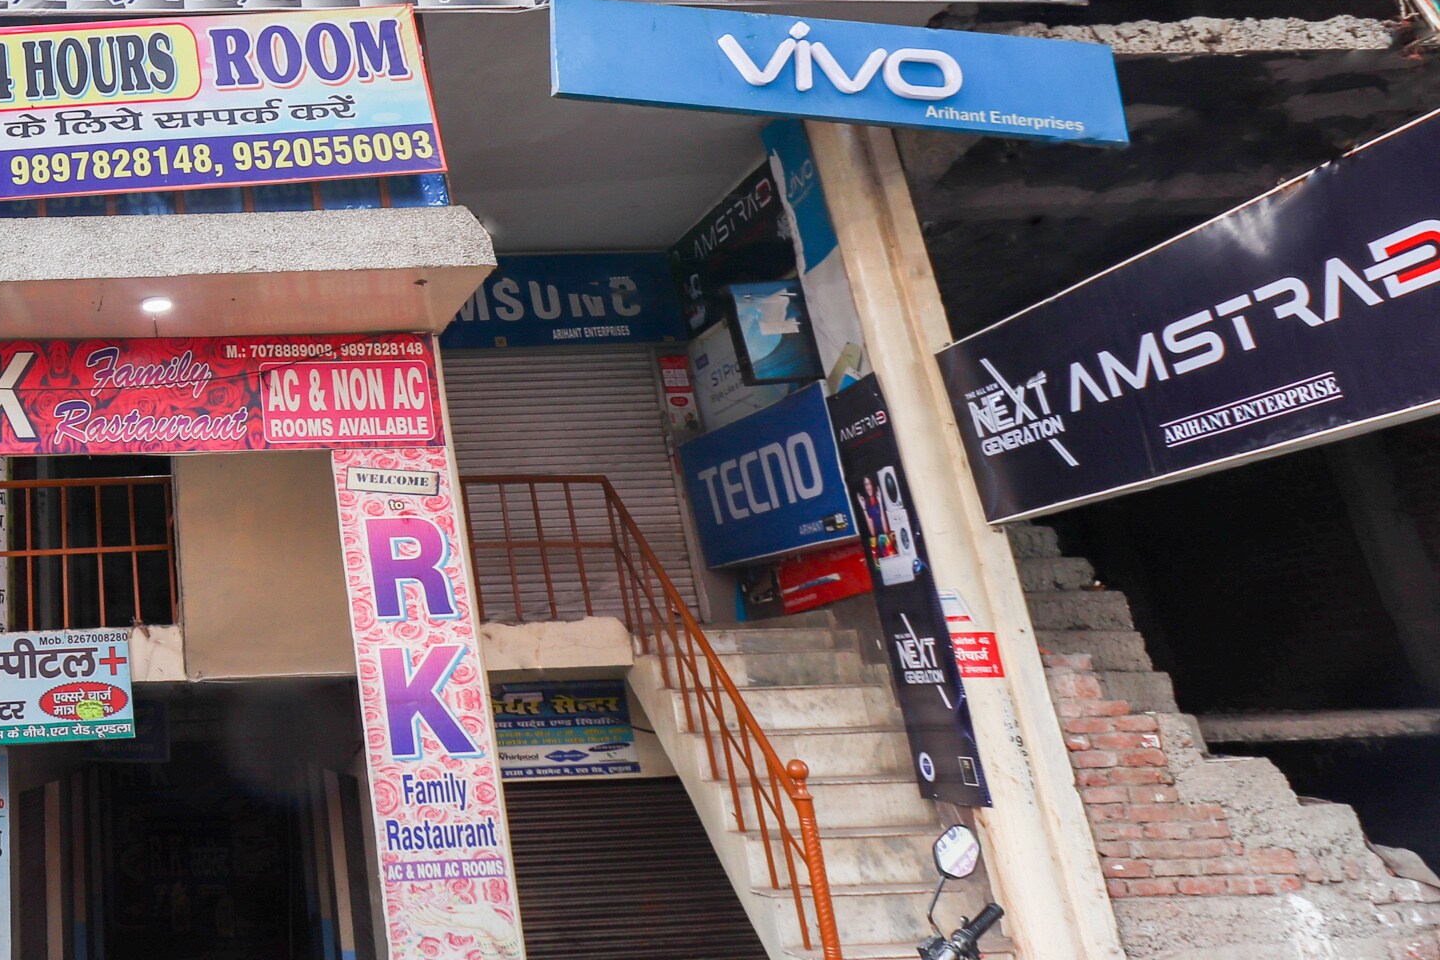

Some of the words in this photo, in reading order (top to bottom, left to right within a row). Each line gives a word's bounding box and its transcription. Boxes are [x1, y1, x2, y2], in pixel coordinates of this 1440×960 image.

[21, 32, 177, 99] HOURS
[207, 19, 412, 88] ROOM
[717, 21, 963, 101] vivo
[5, 114, 46, 138] के
[57, 108, 143, 137] लिये
[154, 98, 286, 131] सम्पर्क
[288, 93, 358, 121] करें
[924, 104, 986, 124] Arihant
[990, 108, 1085, 133] Enterprises
[10, 143, 225, 185] 9897828148,
[232, 130, 435, 172] 9520556093
[86, 346, 213, 398] Family
[341, 342, 424, 357] 9897828148
[268, 369, 301, 412] AC
[309, 368, 328, 412] &
[331, 367, 386, 411] NON
[392, 366, 426, 410] AC
[968, 360, 1051, 438] NEXT
[1164, 411, 1233, 446] ARIHANT
[1233, 377, 1341, 423] ENTERPRISE
[53, 399, 249, 445] Rastaurant
[271, 418, 334, 438] ROOMS
[338, 417, 430, 437] AVAILABLE
[981, 415, 1067, 457] GENERATION
[355, 471, 430, 488] WELCOME
[697, 431, 825, 526] TECNO
[389, 498, 405, 511] to
[363, 516, 460, 619] R
[39, 636, 65, 646] Mob.
[67, 632, 128, 644] 8267008280
[379, 646, 486, 759] K
[403, 774, 467, 811] Family
[386, 818, 498, 852] Rastaurant
[388, 864, 404, 879] AC
[406, 864, 416, 879] &
[416, 863, 442, 879] NON
[444, 863, 460, 878] AC
[462, 861, 504, 878] ROOMS
